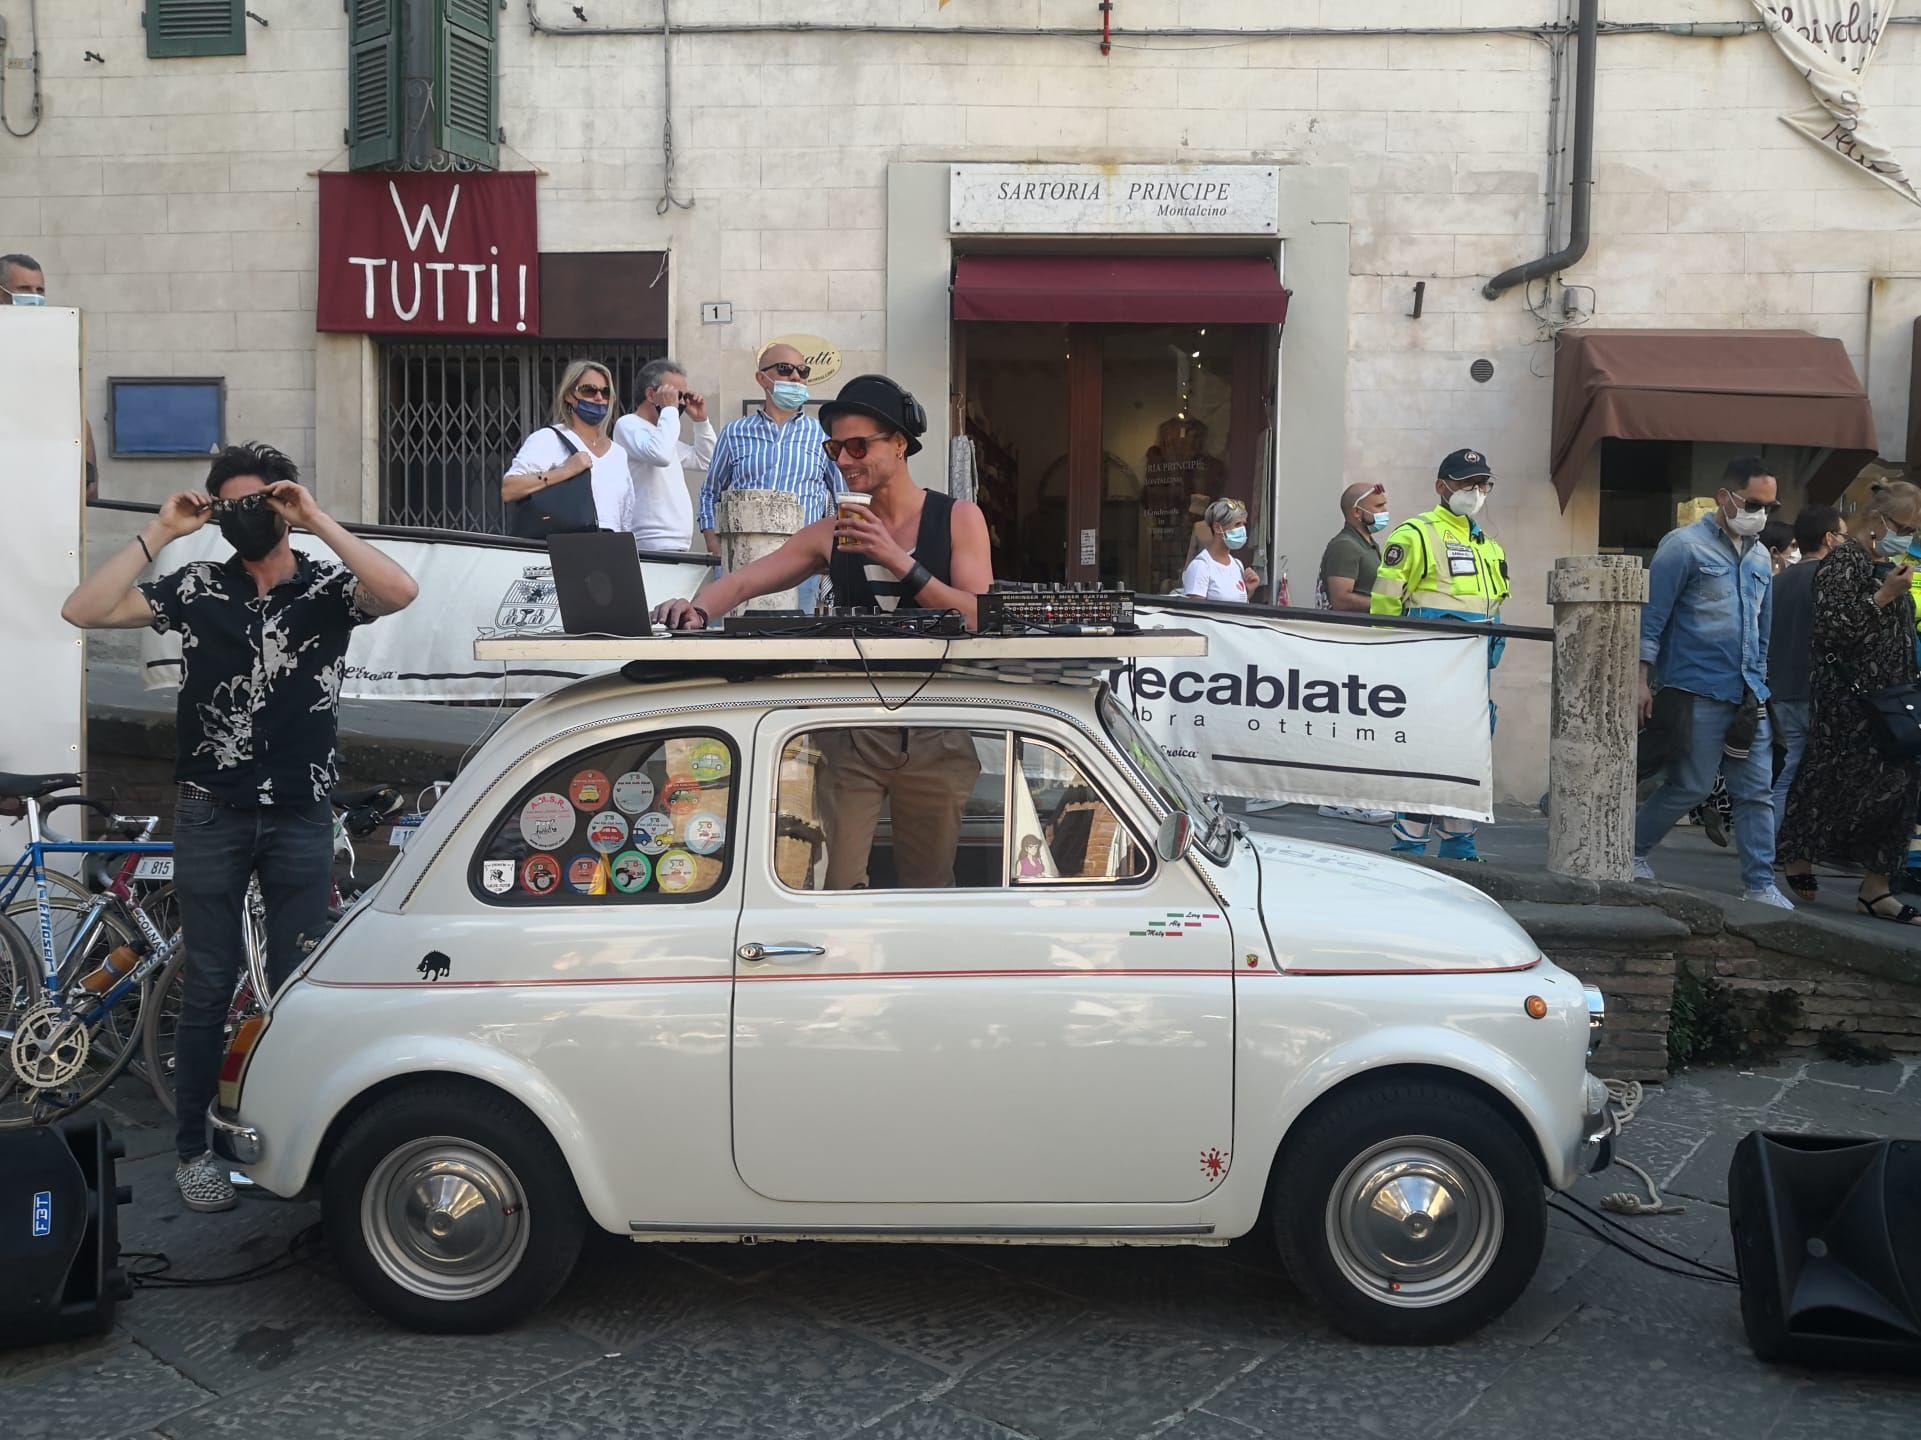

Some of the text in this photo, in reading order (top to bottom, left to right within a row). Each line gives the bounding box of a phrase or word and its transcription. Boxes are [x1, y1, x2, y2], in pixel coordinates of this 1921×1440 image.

[998, 182, 1231, 200] SARTORIA PRINCIPE
[389, 180, 460, 253] W
[1157, 204, 1227, 216] Montalcino
[712, 306, 718, 319] 1
[804, 351, 835, 365] atti
[1108, 664, 1408, 718] recablate
[1141, 706, 1408, 744] bra ottima
[151, 861, 171, 875] 815
[136, 914, 162, 950] COLNA
[35, 1196, 48, 1232] FBT
